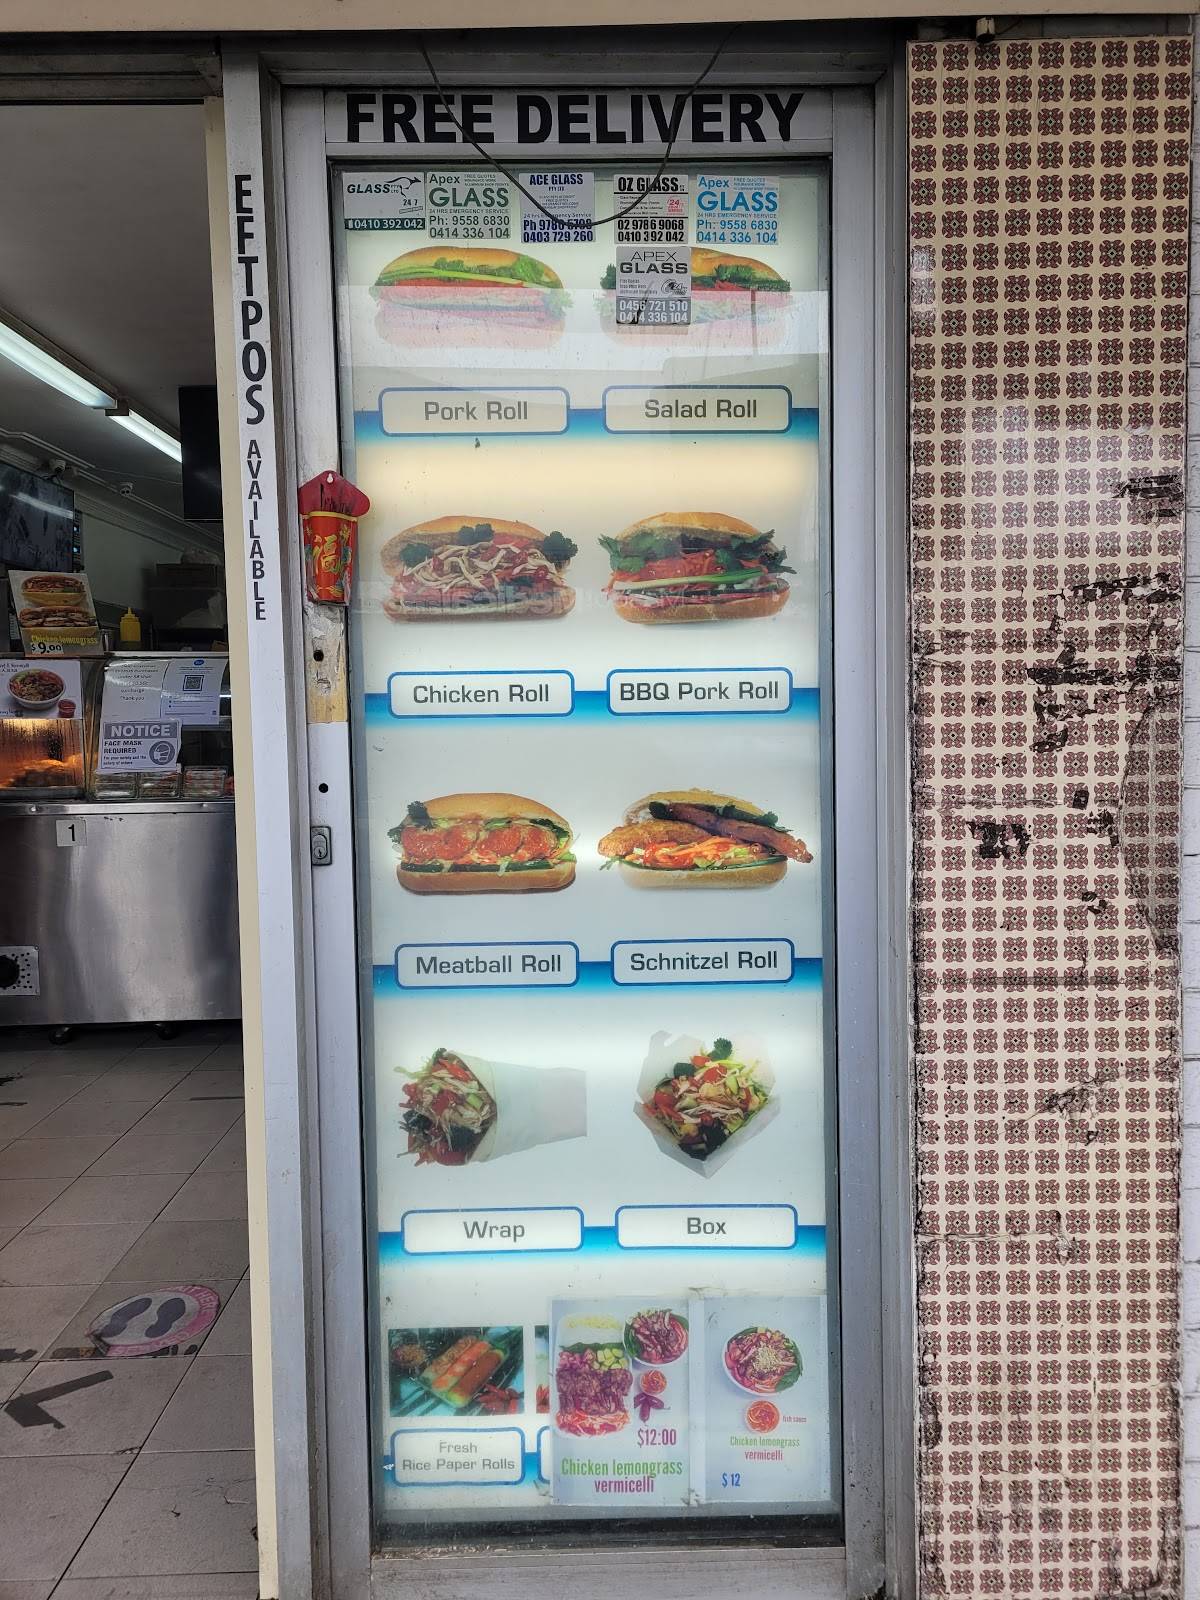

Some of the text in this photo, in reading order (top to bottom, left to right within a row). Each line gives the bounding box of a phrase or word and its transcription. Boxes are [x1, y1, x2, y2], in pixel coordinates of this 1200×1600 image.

[347, 93, 804, 144] FREE DELIVERY
[429, 174, 460, 186] Apex
[529, 173, 583, 185] ACE GLASS
[618, 177, 633, 191] OZ
[637, 177, 679, 191] GLASS
[698, 176, 729, 189] Apex
[347, 184, 391, 194] GLASS
[429, 187, 509, 207] GLASS
[697, 191, 778, 212] GLASS
[354, 219, 423, 229] 0410 392 042
[429, 215, 510, 225] Ph: 9558 6830
[524, 220, 536, 230] Ph
[618, 219, 684, 230] 02 9786 9068
[720, 219, 747, 229] 9558
[751, 220, 778, 230] 6830
[429, 227, 510, 238] 0414 336 104
[523, 231, 593, 243] 0403 729 260
[618, 231, 684, 241] 0410 392 042
[697, 231, 777, 243] 0414 336 104
[631, 251, 677, 262] APEX
[620, 262, 688, 274] GLASS
[620, 300, 688, 311] 0456 721 510
[620, 312, 688, 322] 0414 336 104
[235, 174, 266, 621] EFTPOS AVAILABLE
[424, 401, 528, 420] Pork Roll
[645, 399, 757, 418] Salad Roll
[413, 684, 549, 703] Chicken Roll
[620, 681, 779, 701] BBQ Pork Roll
[111, 724, 171, 736] NOTICE
[68, 823, 76, 842] 1
[416, 954, 562, 975] Meatball Roll
[630, 950, 778, 971] Schnitzel Roll
[463, 1221, 525, 1242] Wrap
[687, 1217, 727, 1236] Box
[637, 1428, 677, 1448] $12:00
[730, 1436, 800, 1448] Chicken lemongrass
[439, 1441, 478, 1454] Fresh
[745, 1450, 783, 1461] vermicelli
[402, 1458, 515, 1472] Rice Paper Rolls
[561, 1458, 683, 1478] Chicken lemongrass
[594, 1476, 654, 1493] vermicelli
